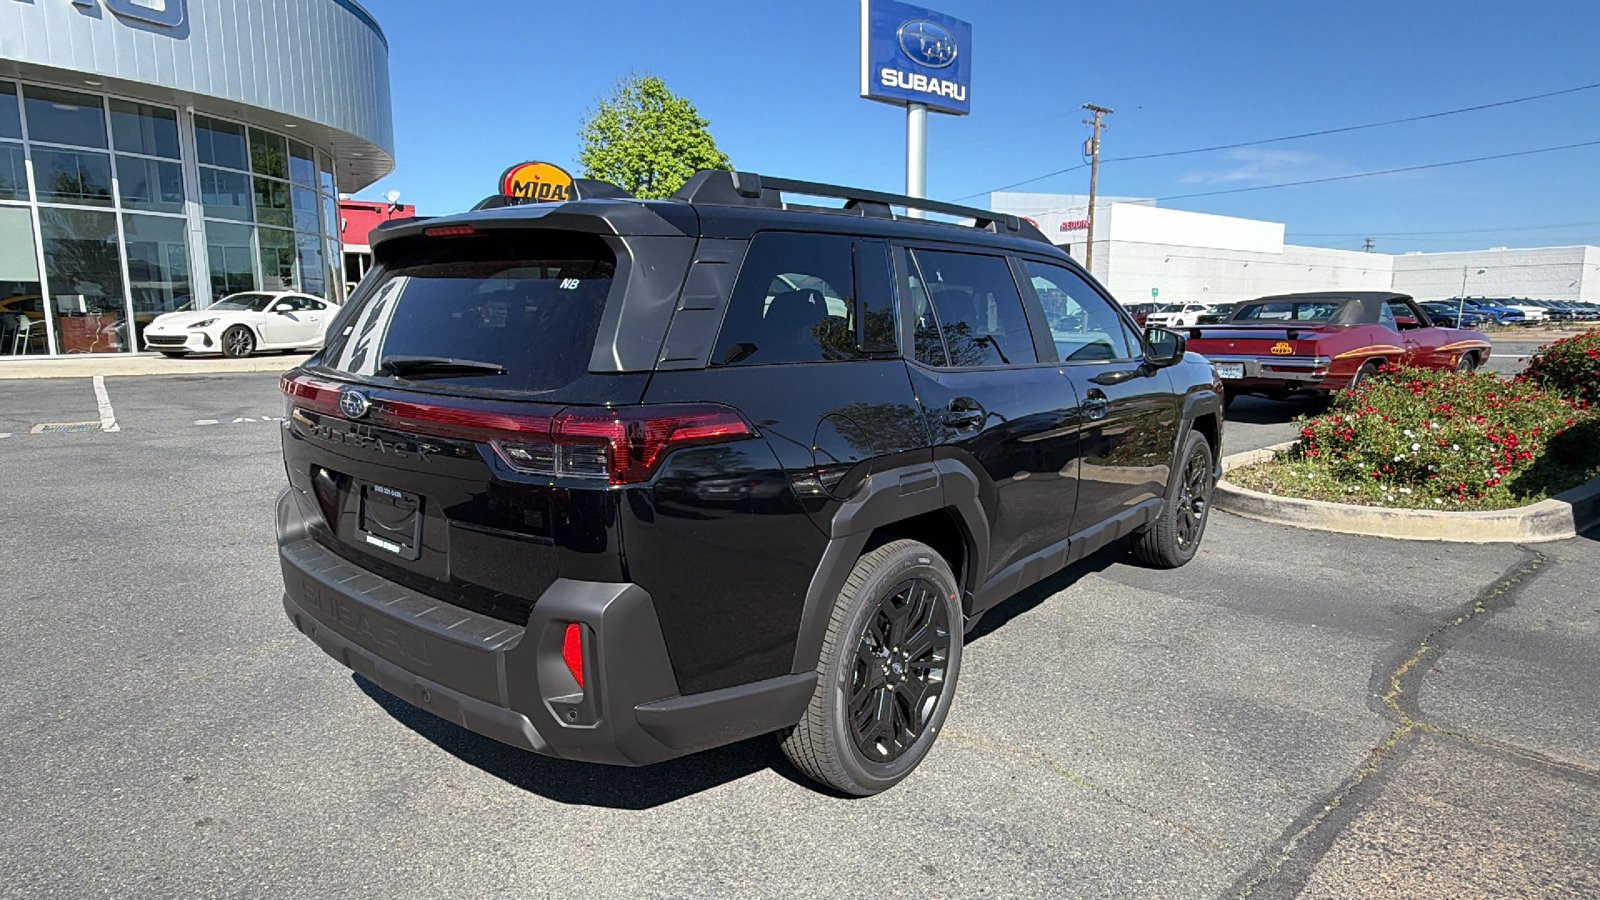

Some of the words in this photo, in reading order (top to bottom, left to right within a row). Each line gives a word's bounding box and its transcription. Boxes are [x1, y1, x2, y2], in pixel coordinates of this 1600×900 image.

[881, 68, 966, 101] SUBARU
[309, 424, 433, 463] OUTBACK
[302, 578, 433, 667] SUBARU
